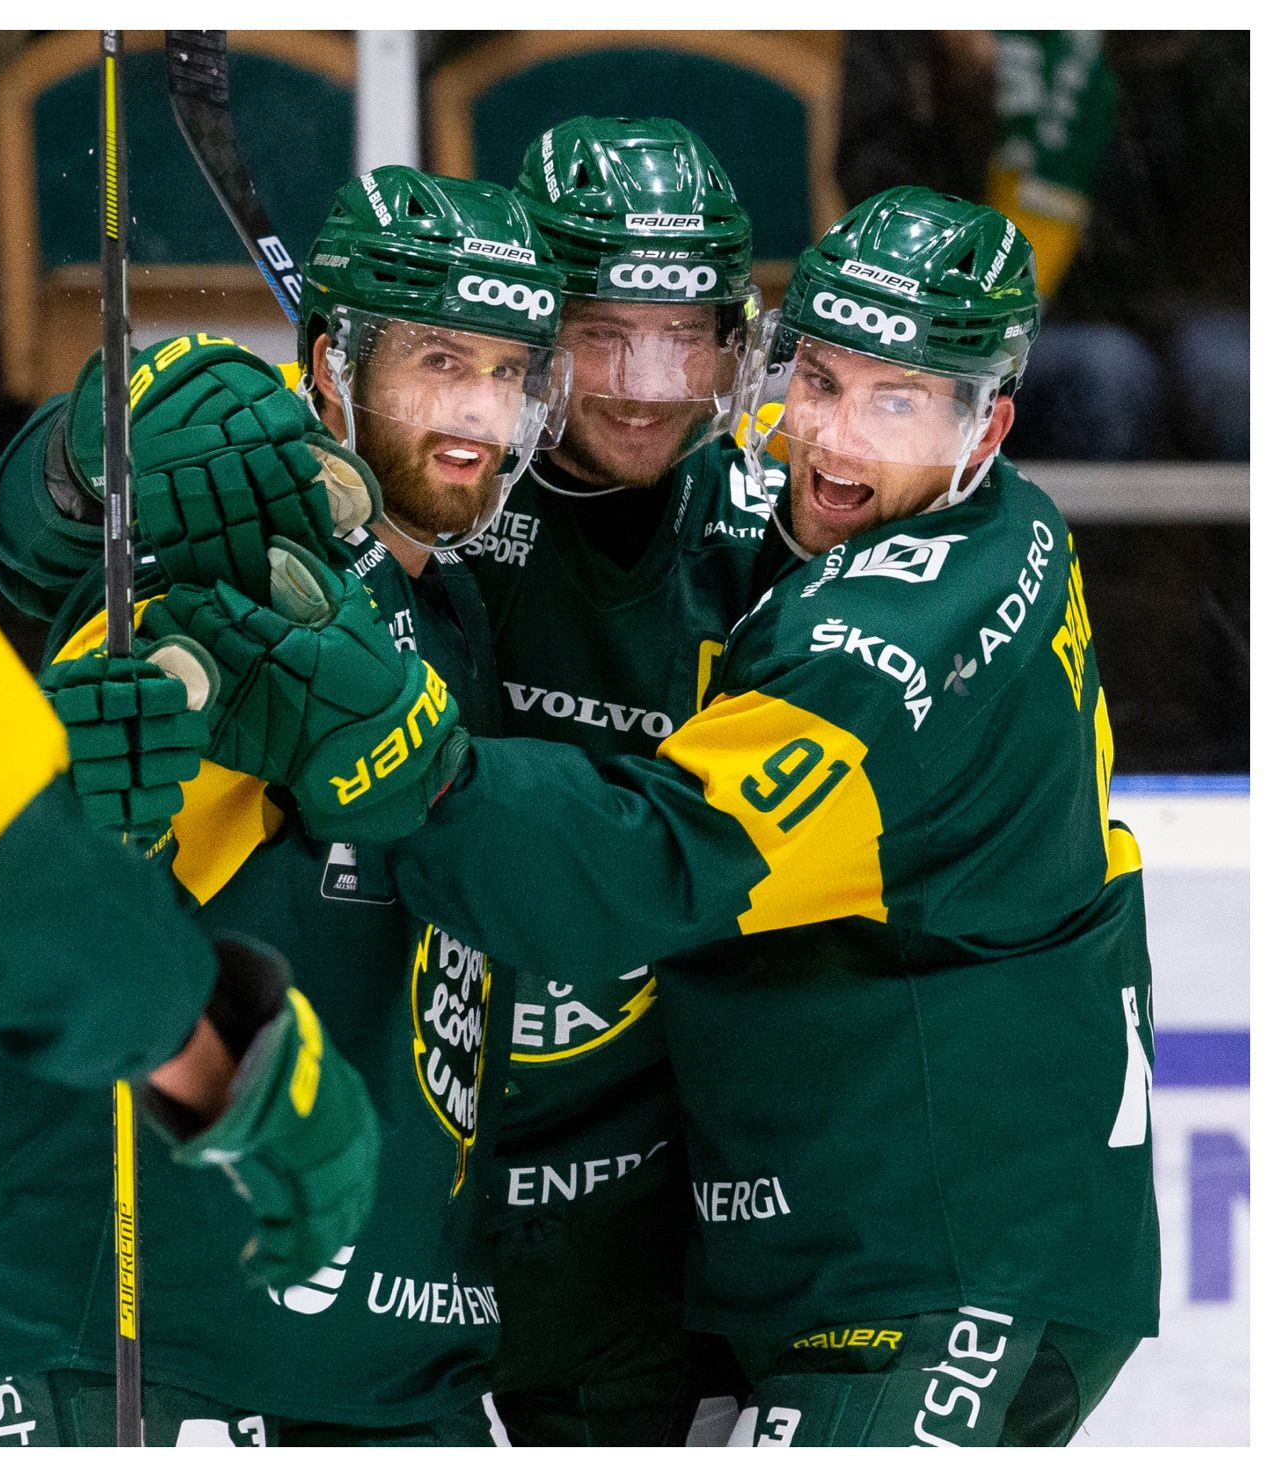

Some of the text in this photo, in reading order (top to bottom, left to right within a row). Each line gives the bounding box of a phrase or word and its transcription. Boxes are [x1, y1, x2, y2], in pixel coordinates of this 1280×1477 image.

[544, 160, 561, 204] BUSS
[368, 190, 393, 227] BUSS
[467, 241, 533, 262] BAUER
[457, 275, 555, 320] coop
[610, 263, 717, 298] coop
[845, 264, 916, 292] BAUER
[812, 291, 917, 345] coop
[464, 533, 534, 567] SPOR
[978, 519, 1055, 665] ADERO
[809, 617, 933, 733] ŠKODA
[327, 659, 448, 806] AUER
[503, 681, 674, 739] VOLVO
[740, 737, 852, 834] 91
[693, 1176, 791, 1223] NERGI
[120, 1202, 135, 1327] SUPREME
[367, 1271, 466, 1325] UMEÅ
